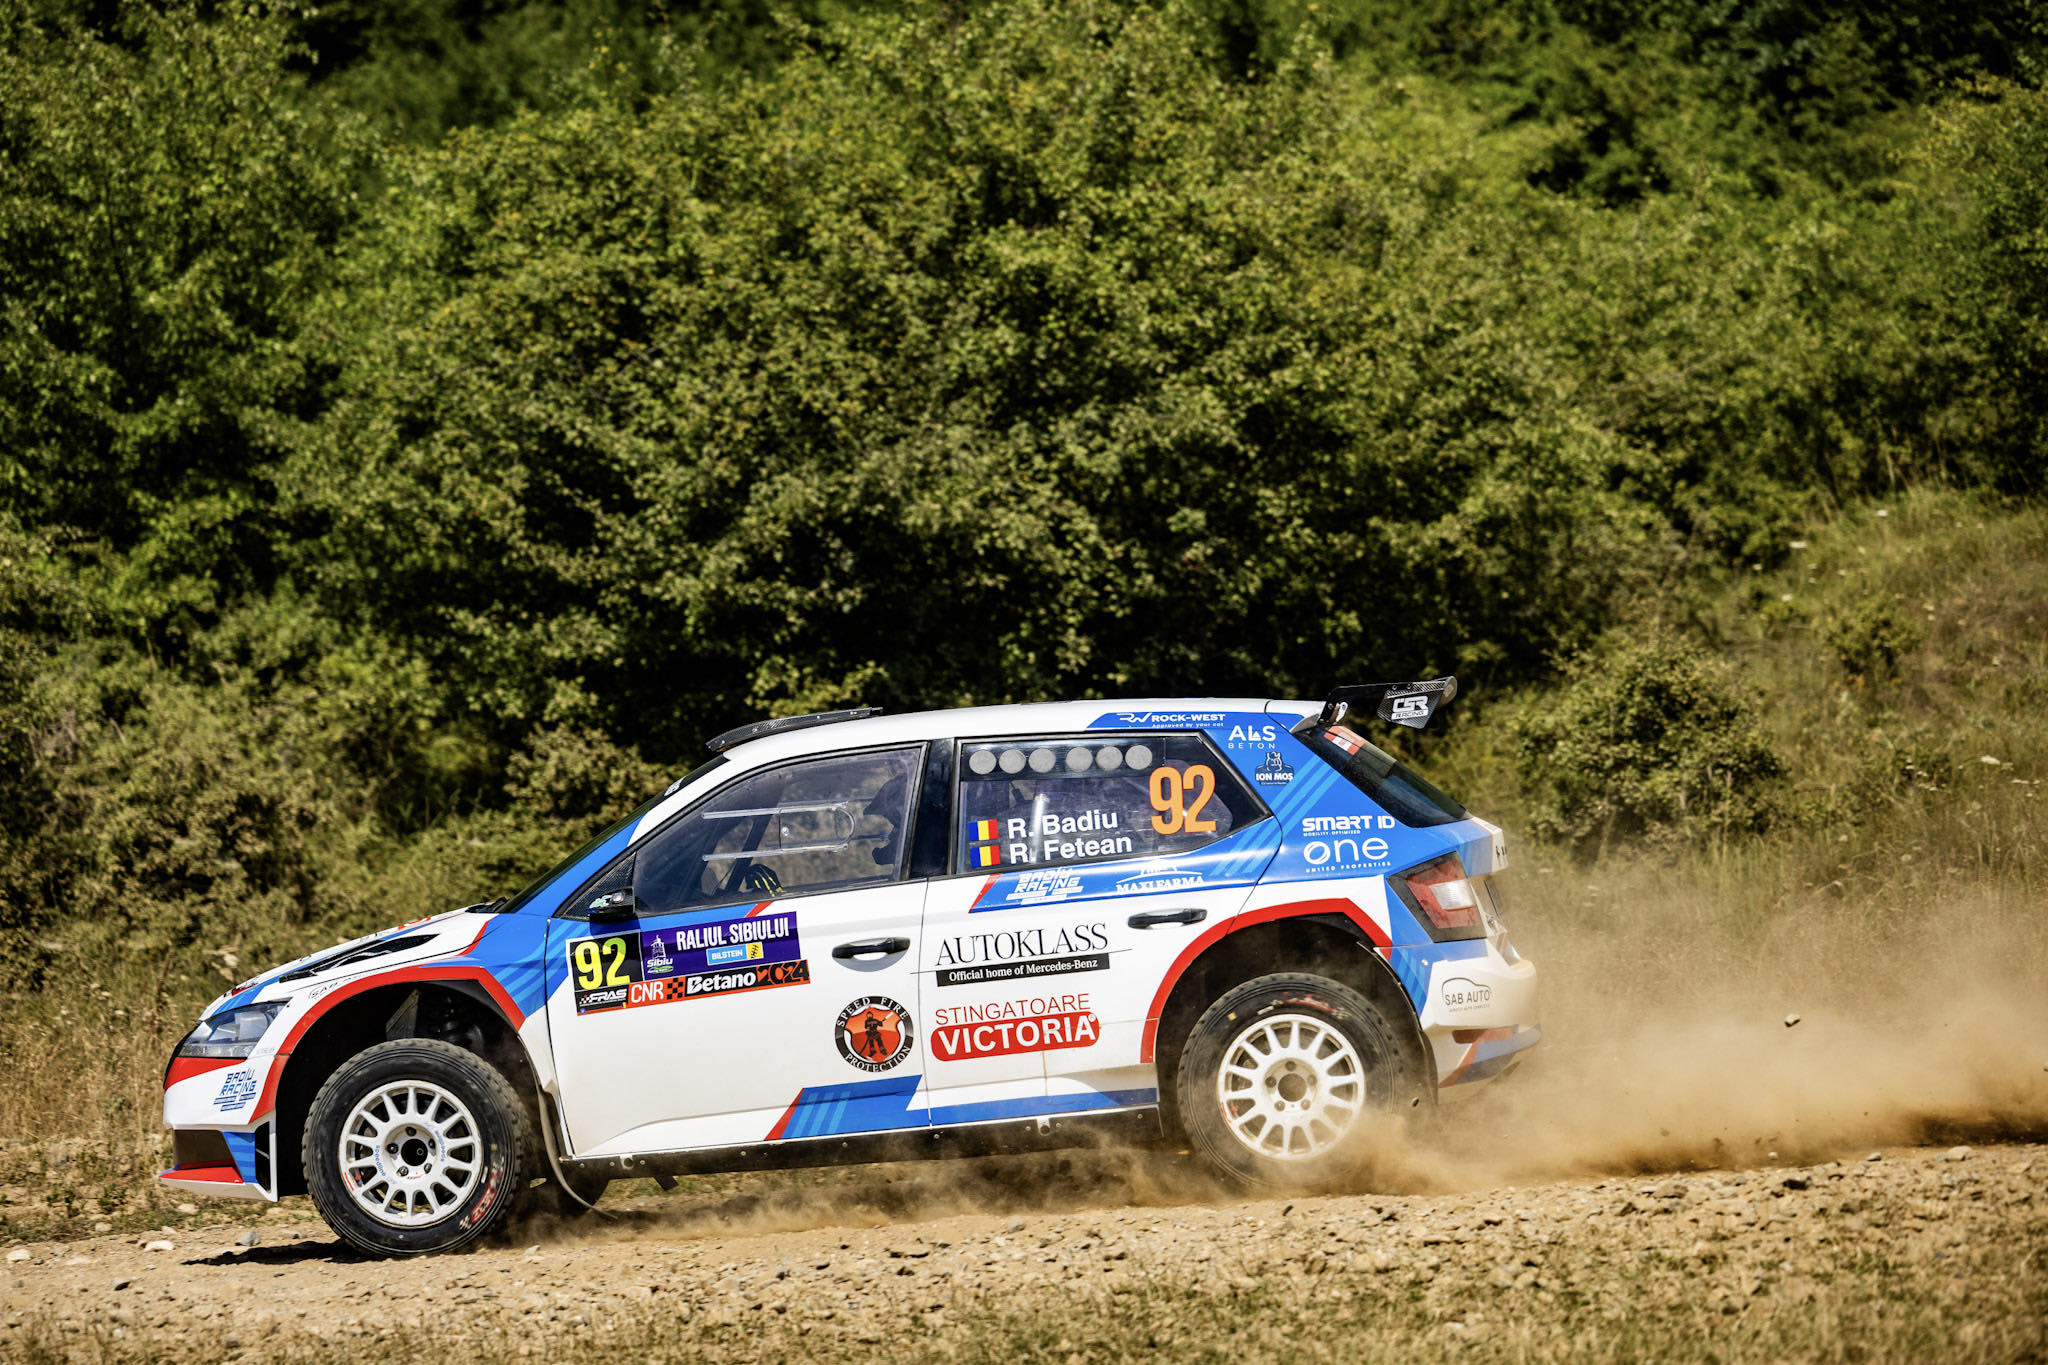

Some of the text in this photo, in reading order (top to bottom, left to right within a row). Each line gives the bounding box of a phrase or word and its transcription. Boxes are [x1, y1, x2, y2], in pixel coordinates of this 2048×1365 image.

[1392, 696, 1429, 713] CSR
[1152, 713, 1226, 722] ROCK-WEST
[1228, 725, 1276, 742] ALS
[1255, 772, 1273, 781] ION
[1149, 764, 1217, 835] 92
[1007, 809, 1119, 840] R. Badiu
[1377, 815, 1396, 829] ID
[1009, 836, 1133, 865] R. Fetean
[1303, 837, 1389, 865] one
[1305, 861, 1391, 873] UNITED PROPERTIES
[1014, 876, 1081, 894] RACING
[676, 917, 790, 951] RALIUL SIBIULUI
[935, 922, 1109, 967] AUTOKLASS
[574, 937, 631, 991] 92
[647, 958, 674, 968] Sibiu
[711, 949, 744, 960] BILSTEIN
[686, 960, 808, 995] Betano 2024
[948, 958, 1099, 982] Official home of Mercedes-Benz
[588, 988, 628, 1004] FRAS
[630, 981, 665, 1004] CNR
[1444, 989, 1490, 1006] SAB AUTO
[836, 997, 909, 1027] SPEED FIRE
[935, 993, 1091, 1026] STINGATOARE
[845, 1045, 911, 1072] PROTECTION
[219, 1080, 257, 1096] RACING
